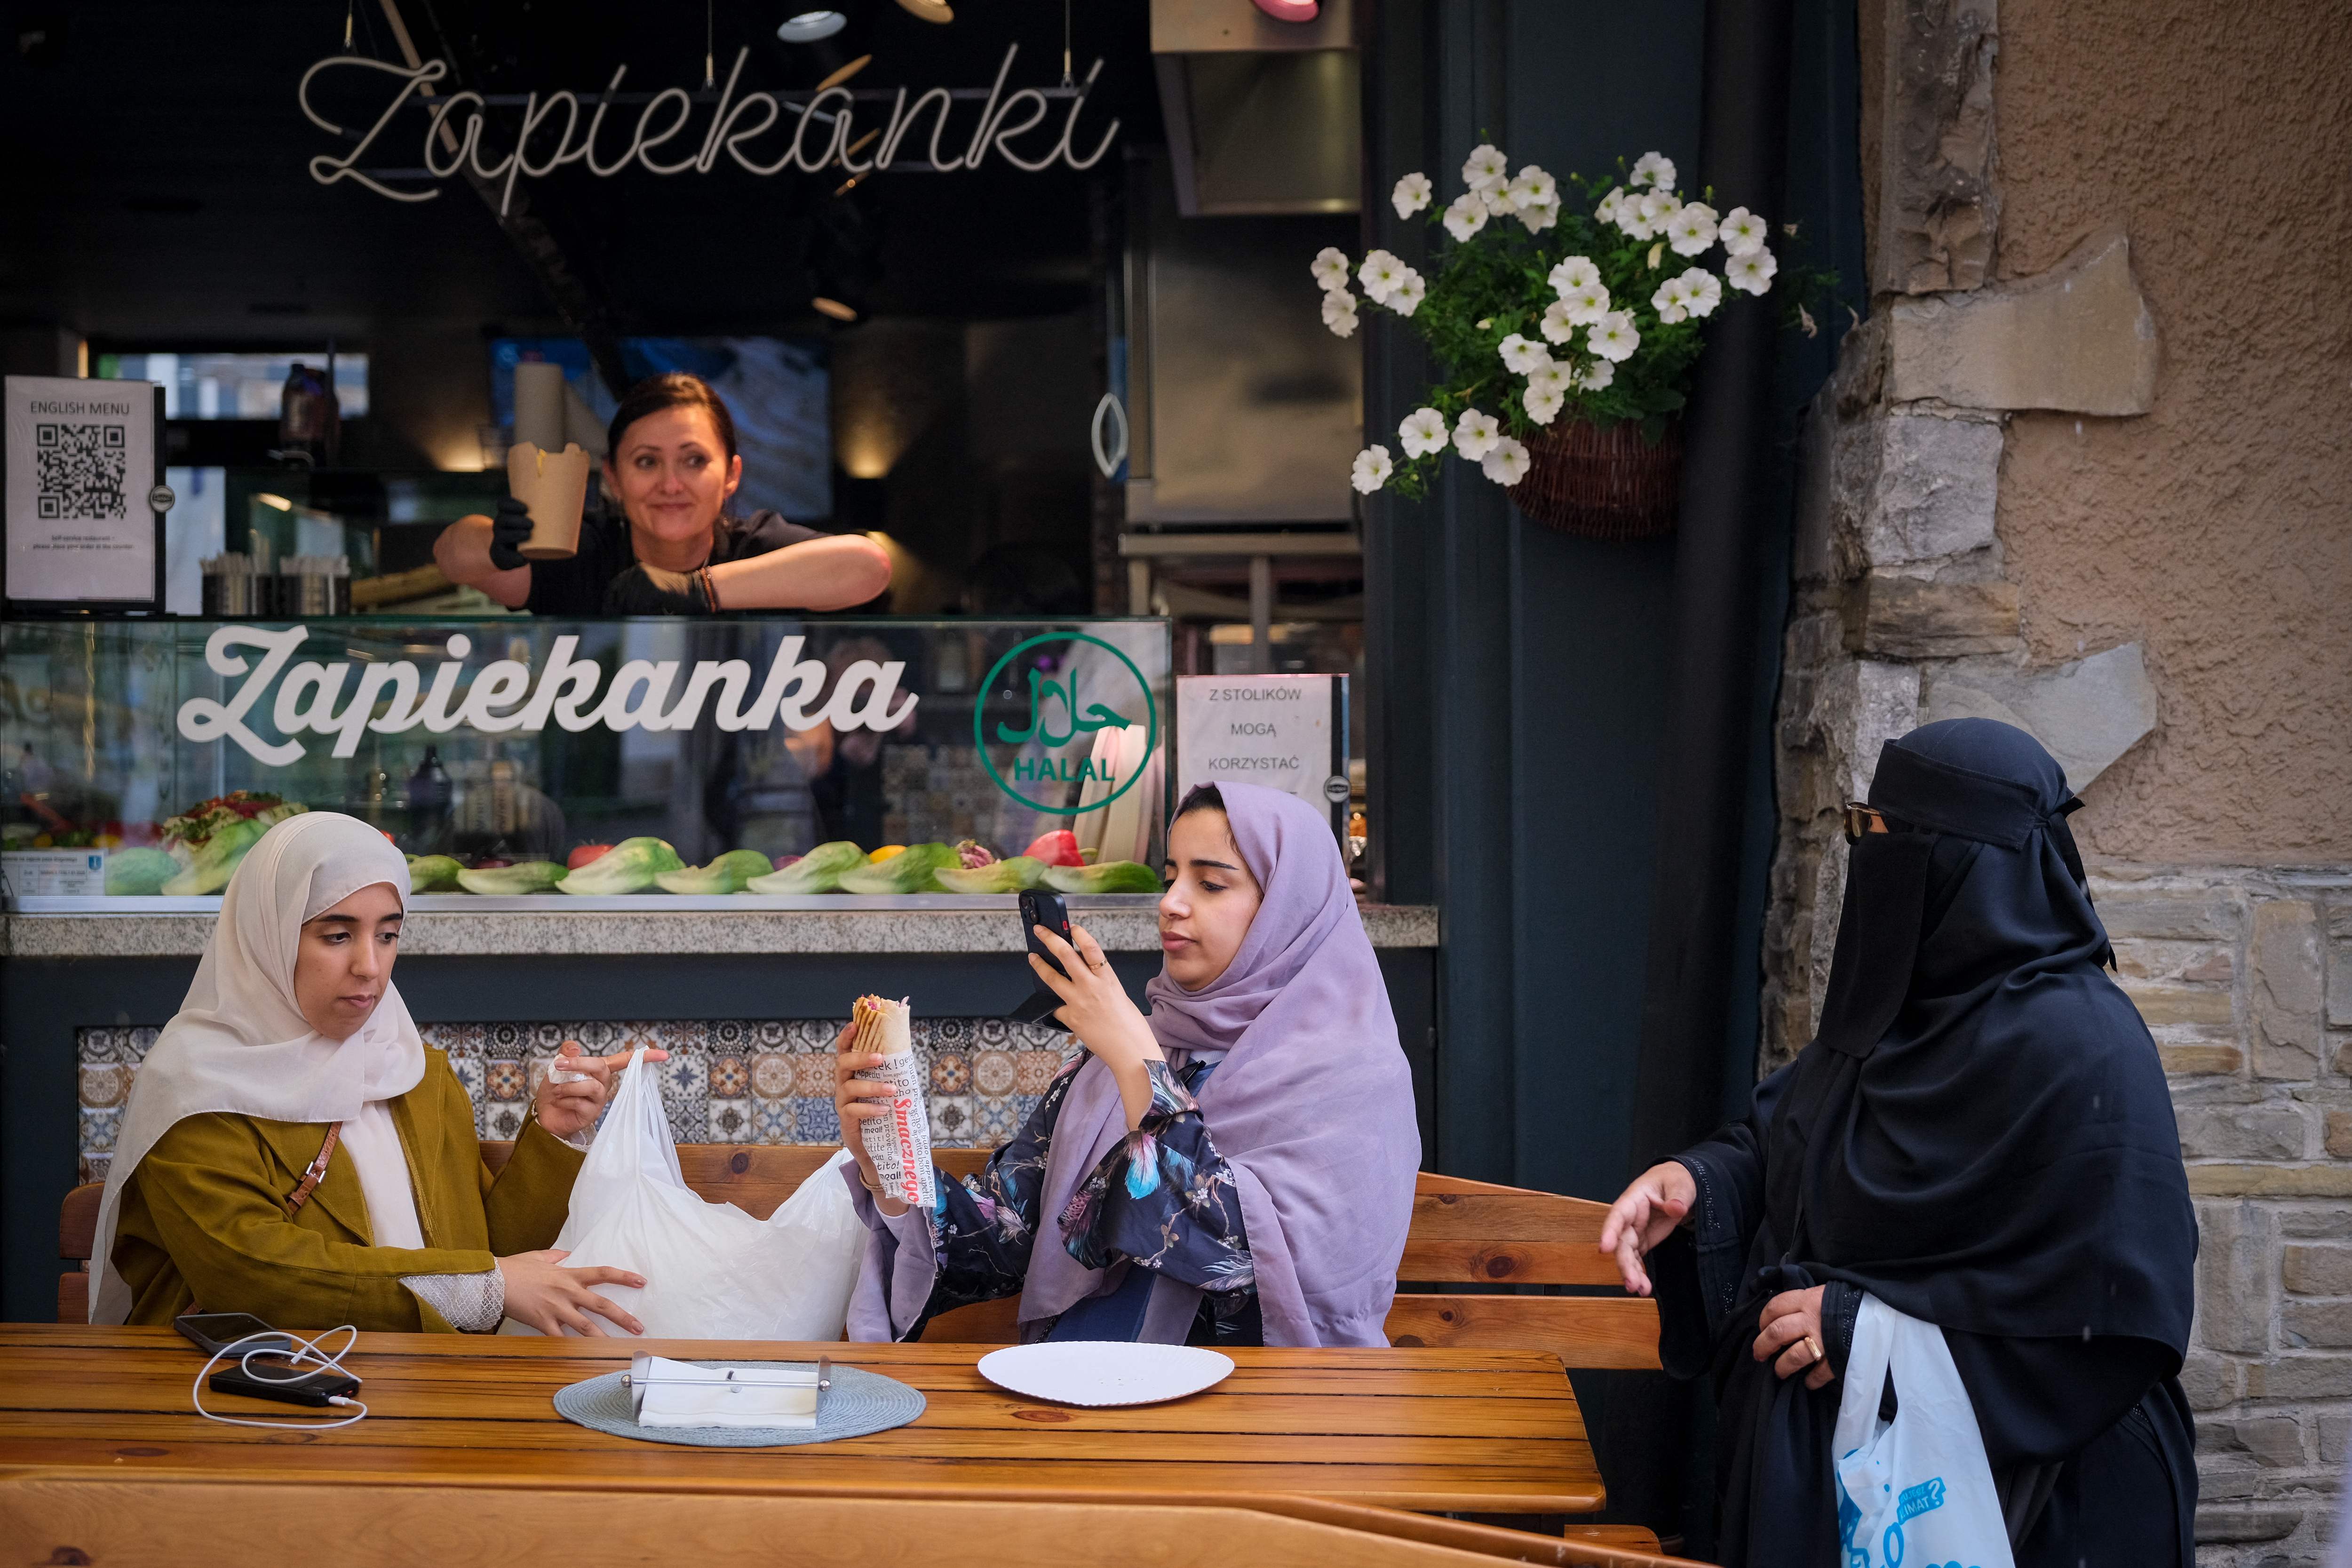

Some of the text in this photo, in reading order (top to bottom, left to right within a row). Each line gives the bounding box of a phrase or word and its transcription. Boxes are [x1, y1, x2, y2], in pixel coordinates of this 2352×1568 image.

[299, 43, 1120, 216] Zapiekanki
[31, 401, 130, 414] ENGLISH MENU
[177, 624, 920, 768] Zapiekanka
[1209, 686, 1302, 700] Z STOLIKÓW
[997, 667, 1132, 747] حلال
[1231, 723, 1276, 737] MOGĄ
[1208, 755, 1300, 769] KORZYSTAĆ
[1013, 757, 1115, 782] HALAL
[874, 1060, 892, 1070] ek
[857, 1069, 880, 1079] Appetit!
[858, 1116, 882, 1125] petito
[866, 1143, 885, 1152] etite
[884, 1124, 893, 1161] provecho
[894, 1098, 919, 1204] Smacznego
[877, 1160, 900, 1170] tito!
